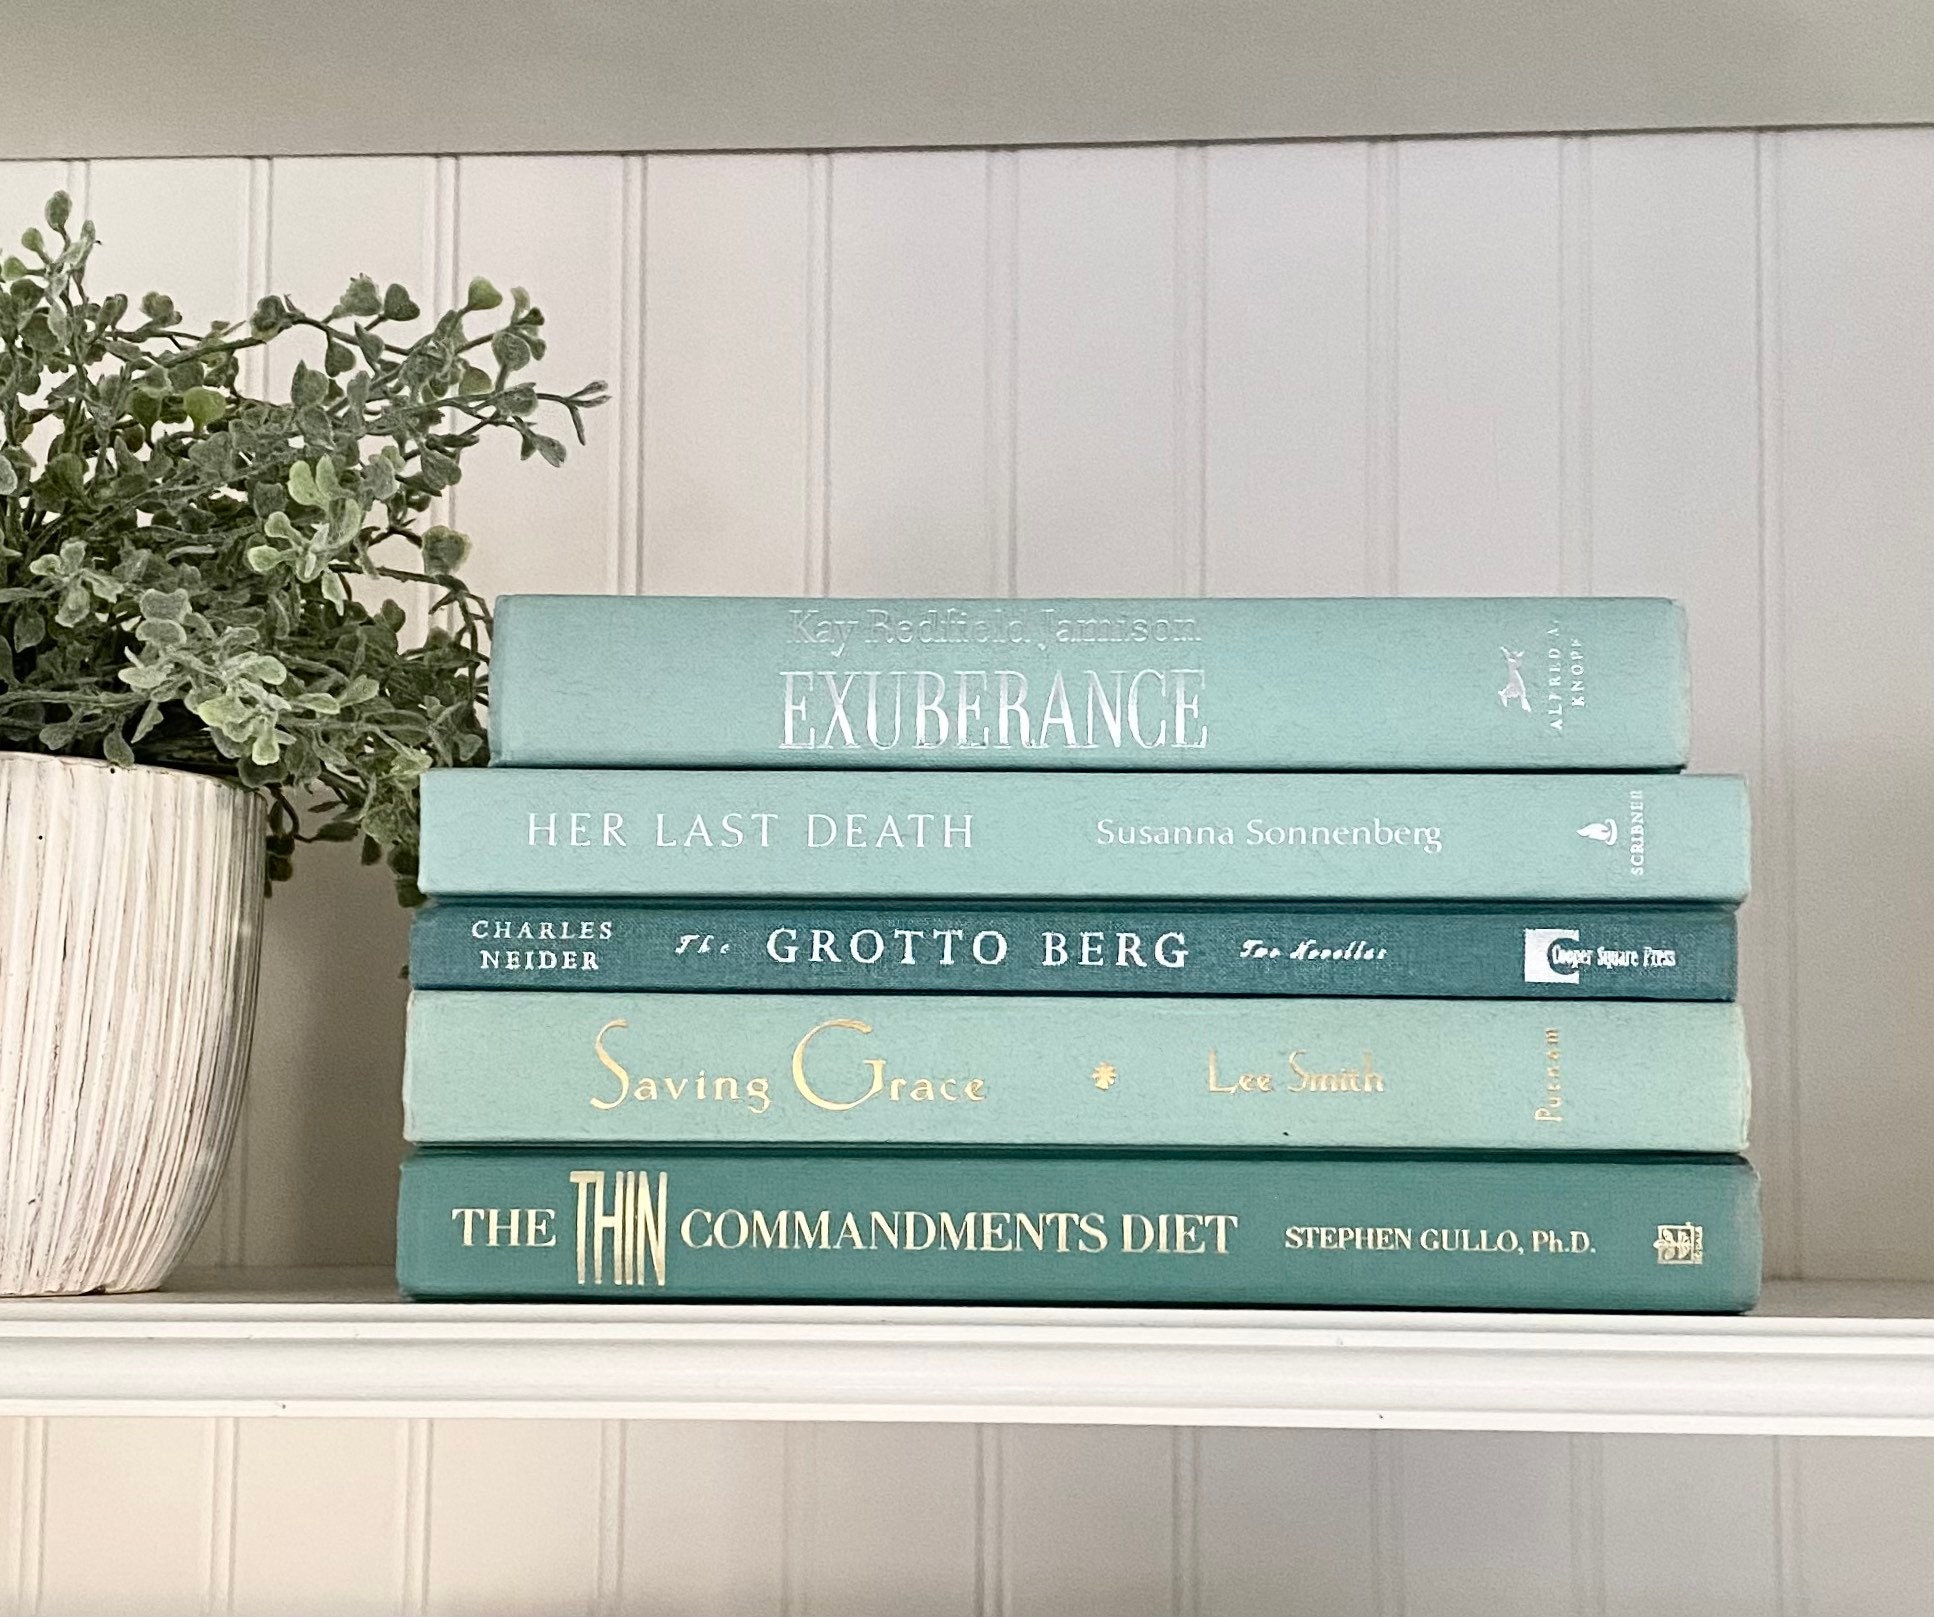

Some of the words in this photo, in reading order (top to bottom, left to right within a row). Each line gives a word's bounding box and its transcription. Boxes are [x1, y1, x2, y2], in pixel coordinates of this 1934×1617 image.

[787, 608, 859, 657] Kay
[865, 608, 1032, 645] Redfield
[1036, 608, 1202, 651] Jamison
[1547, 648, 1563, 731] ALFRED
[1570, 638, 1585, 708] KNOPF
[778, 669, 1208, 750] EXUBERANCE
[527, 813, 627, 847] HER
[655, 813, 779, 848] LAST
[806, 813, 974, 849] DEATH
[1097, 819, 1235, 846] Susanna
[1246, 818, 1443, 854] Sonnenberg
[1630, 790, 1644, 876] SCRIBNER
[471, 920, 613, 940] CHARLES
[675, 934, 730, 955] The
[766, 928, 1008, 968] GROTTO
[1042, 930, 1189, 968] BERG
[480, 950, 599, 971] NEIDER
[1597, 946, 1639, 969] Square
[1643, 946, 1676, 967] Press
[590, 1019, 772, 1113] Saving
[792, 1018, 986, 1111] Grace
[1207, 1048, 1273, 1095] Lee
[1288, 1049, 1386, 1094] Smith
[452, 1208, 556, 1247] THE
[570, 1171, 668, 1286] THIN
[681, 1208, 1106, 1254] COMMANDMENTS
[1121, 1213, 1239, 1255] DIET
[1284, 1226, 1413, 1251] STEPHEN
[1420, 1229, 1525, 1256] GULLO,
[1532, 1231, 1596, 1254] Ph.D.
